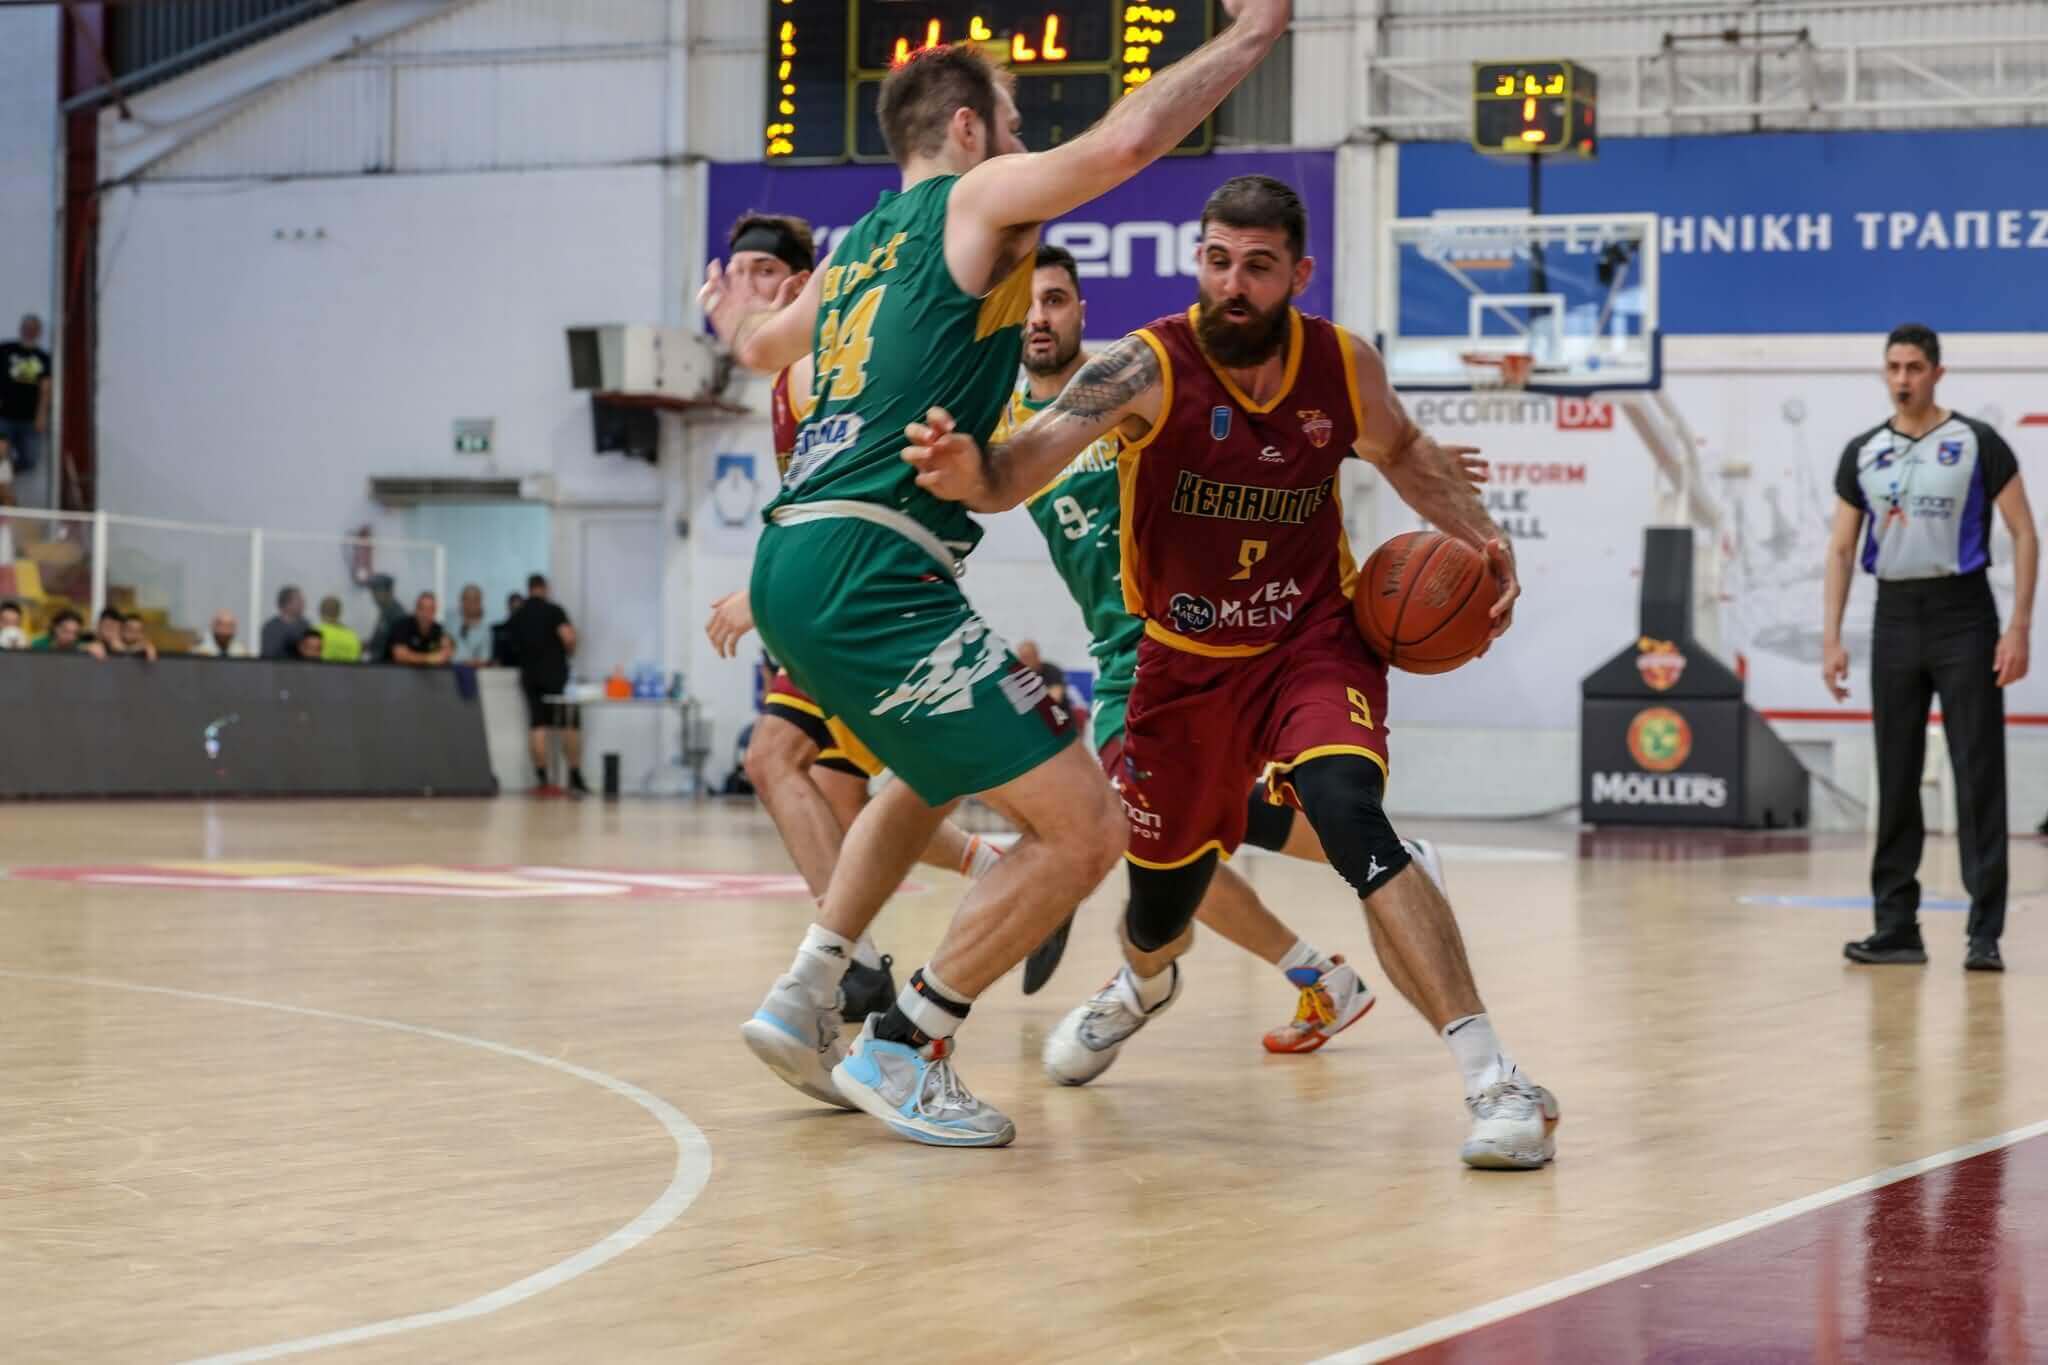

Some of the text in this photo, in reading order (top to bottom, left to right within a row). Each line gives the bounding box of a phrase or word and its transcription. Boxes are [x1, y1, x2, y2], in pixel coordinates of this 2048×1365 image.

[1855, 210, 2048, 250] ΤΡΑΠΕΖ
[1053, 495, 1091, 540] 9
[1228, 539, 1268, 581] 9
[1217, 601, 1294, 629] MEN
[1220, 577, 1302, 619] NVEA
[1346, 687, 1374, 730] 9
